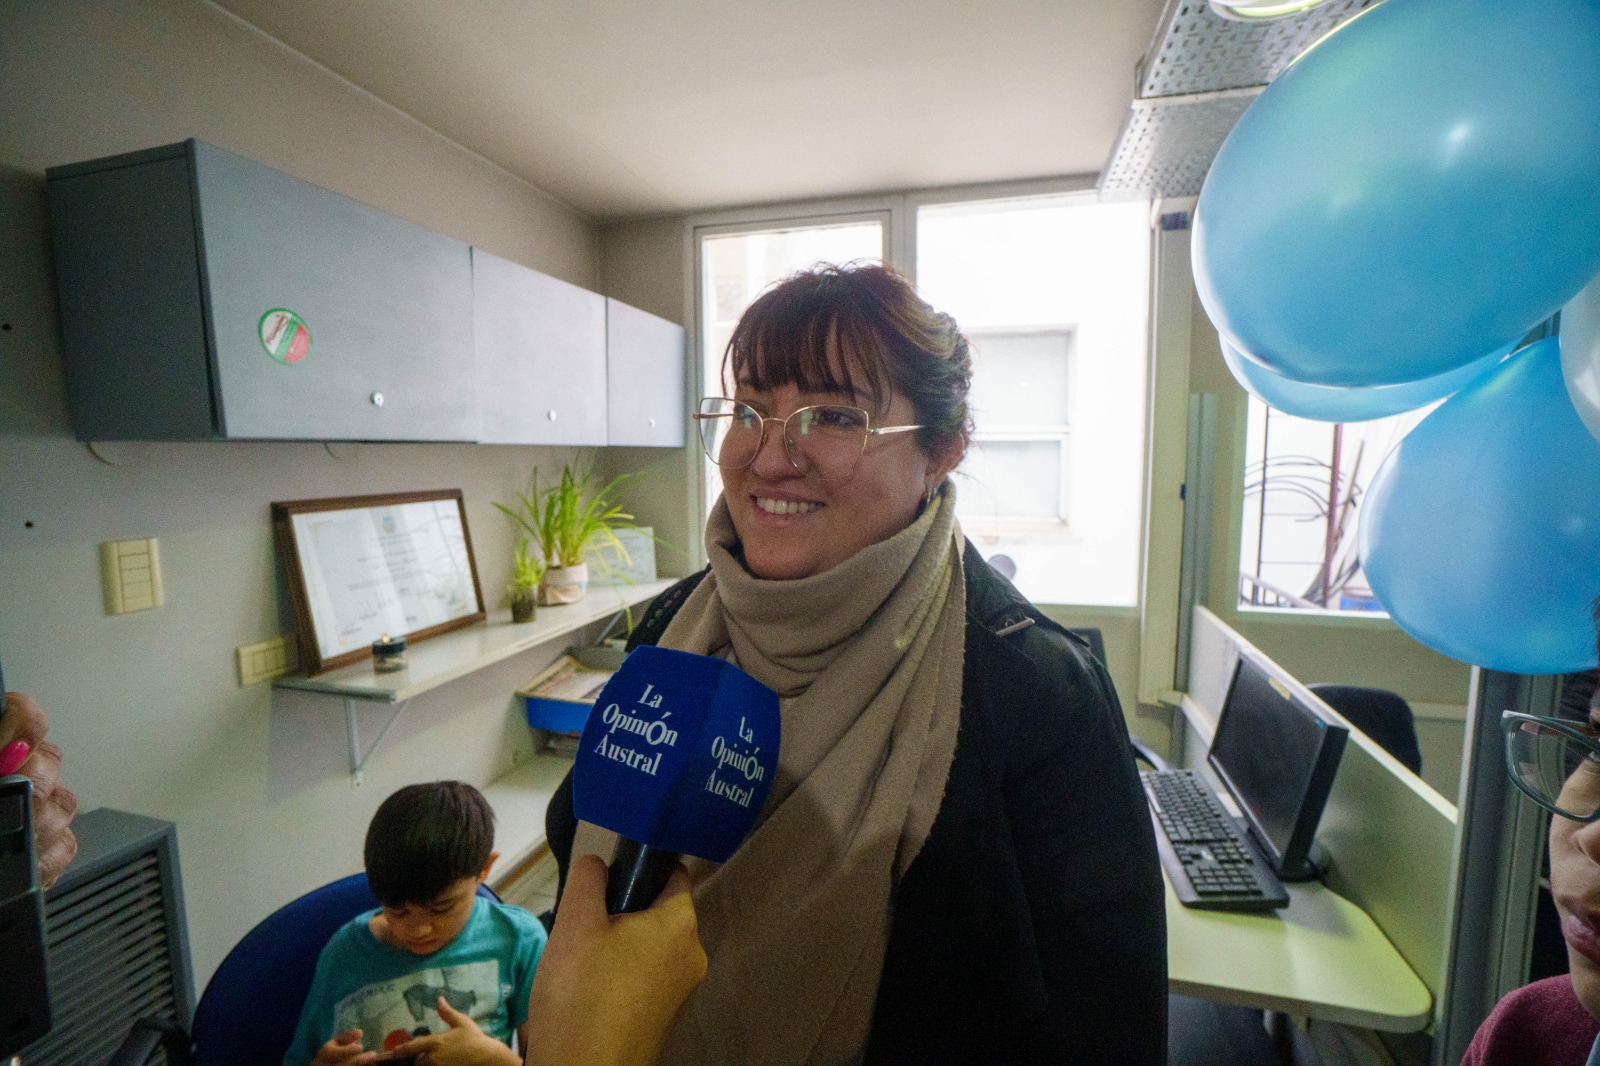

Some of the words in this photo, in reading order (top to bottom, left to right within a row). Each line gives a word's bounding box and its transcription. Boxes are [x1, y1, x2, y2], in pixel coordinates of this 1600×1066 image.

[638, 684, 663, 709] La
[739, 716, 753, 744] La
[594, 734, 662, 776] Austral
[704, 770, 754, 808] Austral
